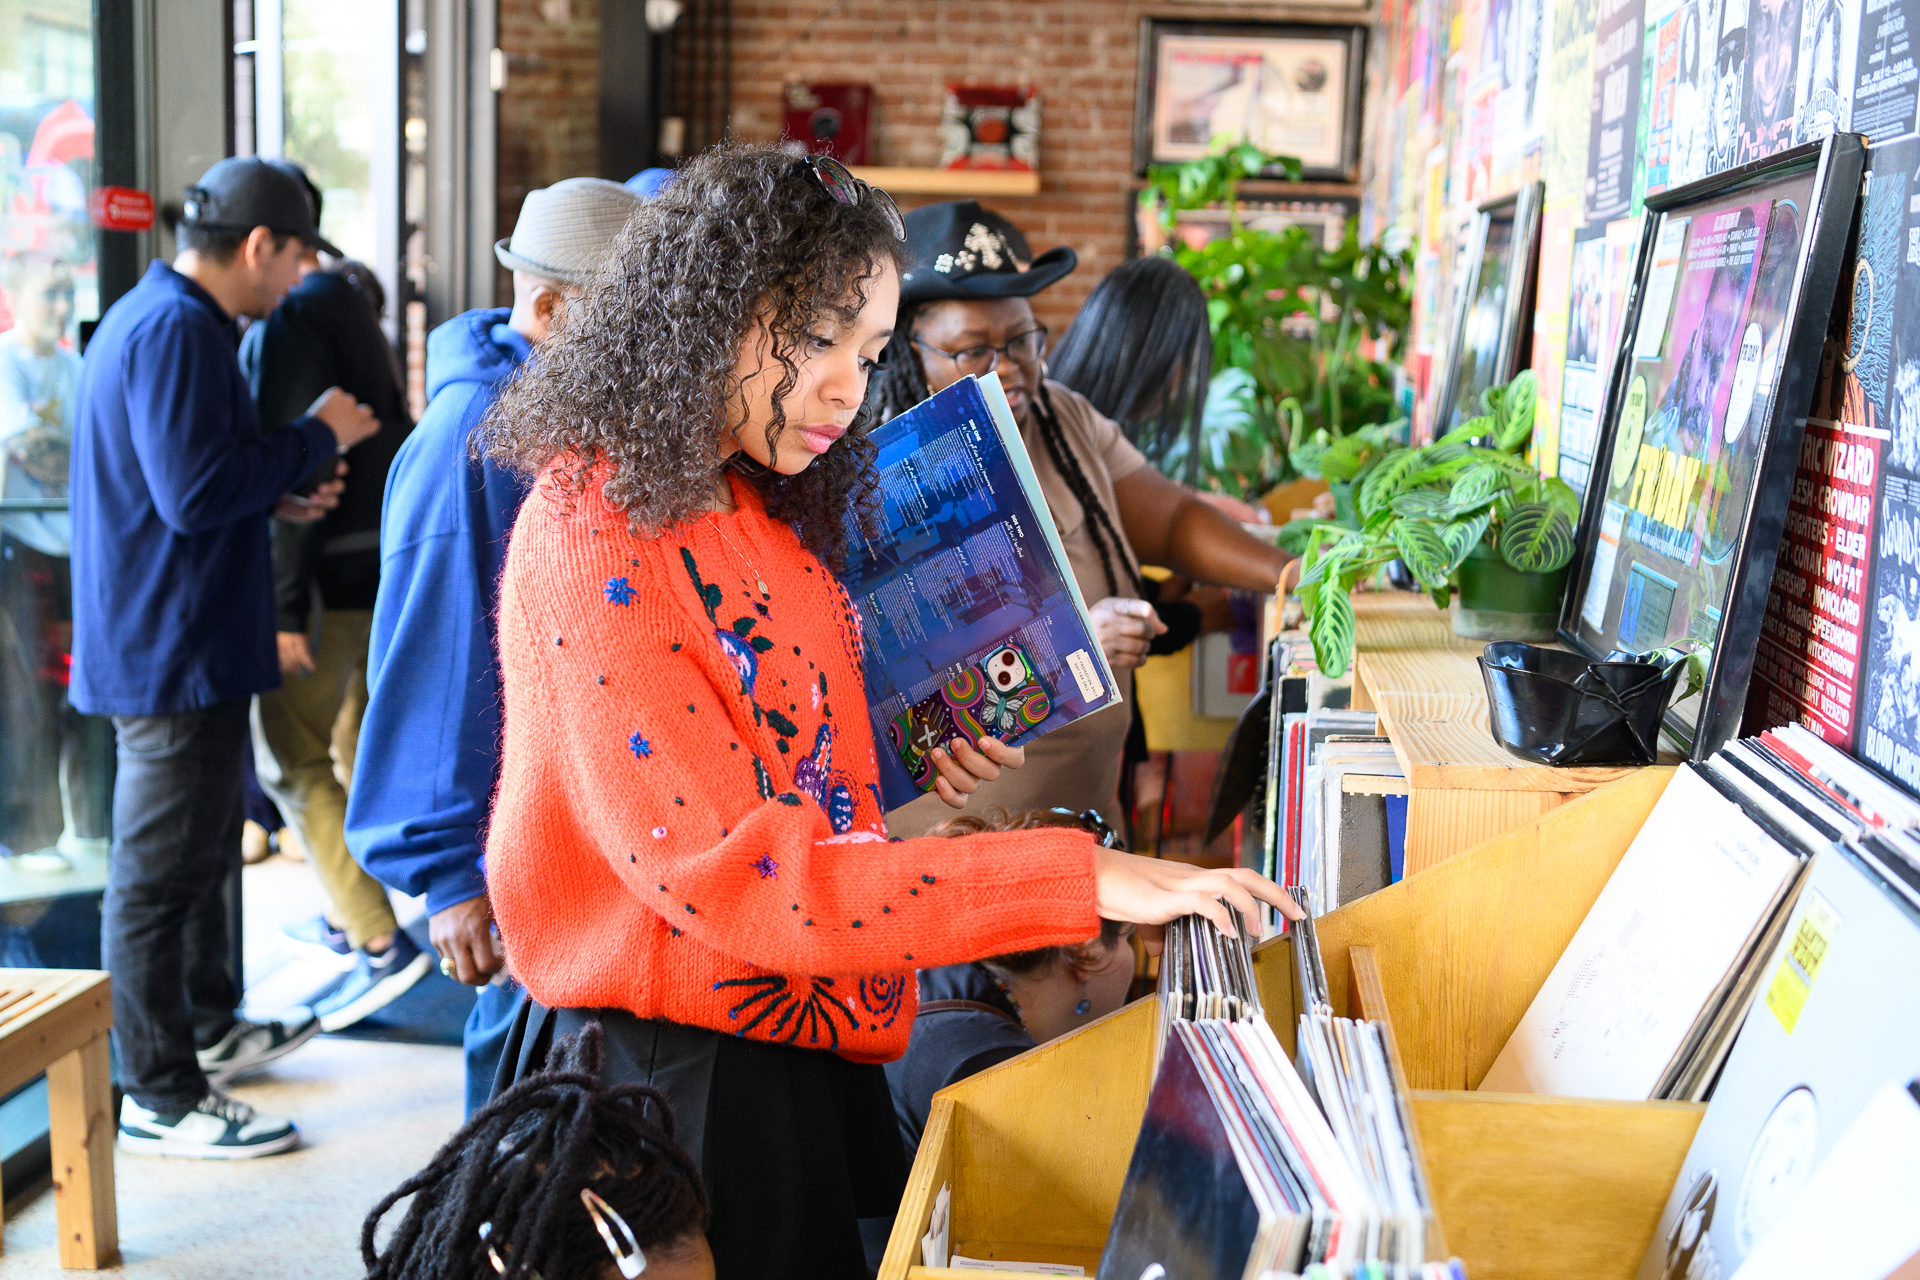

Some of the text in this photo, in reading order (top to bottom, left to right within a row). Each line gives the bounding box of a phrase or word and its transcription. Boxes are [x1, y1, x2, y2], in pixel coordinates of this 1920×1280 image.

[968, 419, 982, 442] SIDE ONE
[1824, 439, 1875, 486] WIZARD
[1629, 443, 1700, 532] FRIDAY
[1818, 486, 1870, 526] CROWBAR
[1016, 525, 1024, 538] TWO
[1785, 510, 1866, 560] KFIGHTERS ELDER
[1794, 544, 1822, 576] CONAN
[1826, 557, 1863, 594] WO-FAT
[1786, 600, 1812, 631] RAGING
[1812, 614, 1858, 656] SPEEDHORN
[1813, 584, 1860, 626] MONOLORD
[1079, 661, 1092, 685] PROMOTION
[1778, 621, 1786, 638] OF
[1786, 626, 1802, 648] ZEUS
[1807, 637, 1855, 680] WITCHSORROW
[1794, 678, 1820, 706] HOLIDAY
[1820, 694, 1850, 726] WEEKEND
[1807, 670, 1824, 690] SLUDGE
[1826, 680, 1836, 698] AND
[1836, 688, 1851, 708] MORE
[1781, 700, 1797, 720] APRIL
[1800, 712, 1811, 730] 1ST
[1811, 718, 1825, 738] MAY
[1865, 724, 1920, 793] BLOOD CIRCU
